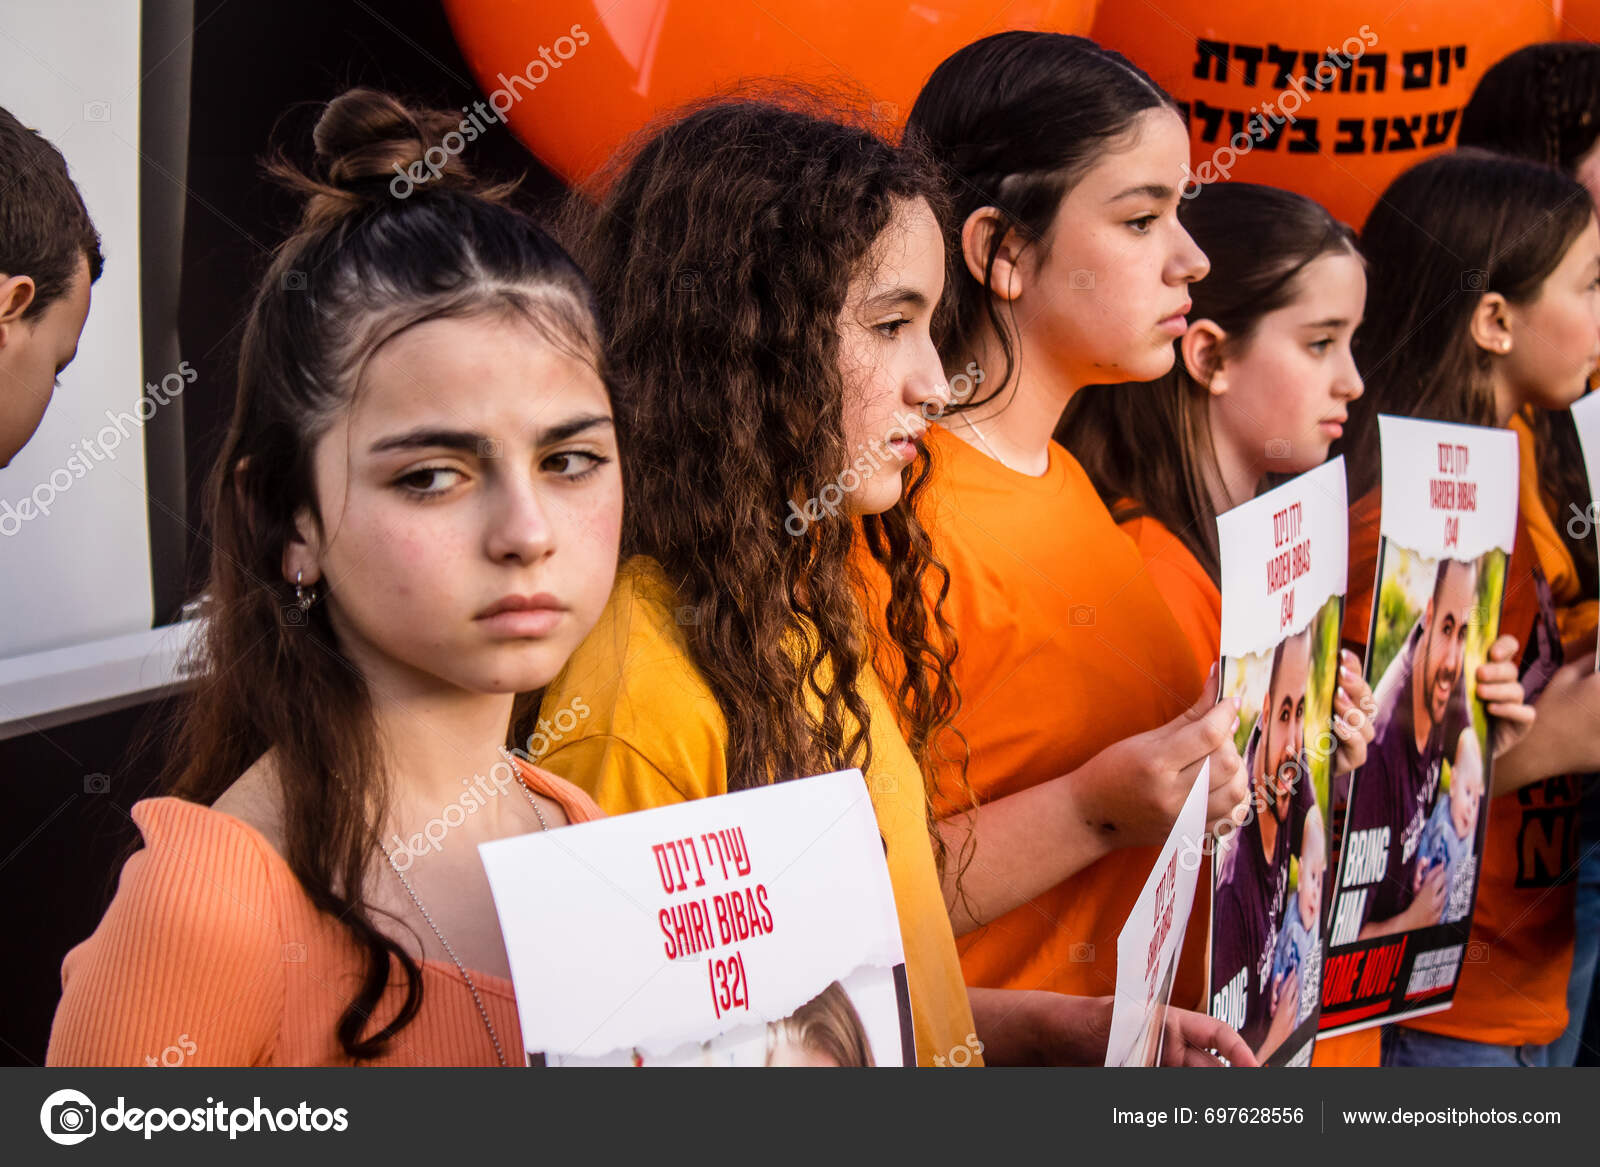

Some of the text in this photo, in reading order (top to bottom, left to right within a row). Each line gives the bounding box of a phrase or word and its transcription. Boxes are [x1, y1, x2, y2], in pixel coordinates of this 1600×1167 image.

[1401, 45, 1466, 90] יום
[1267, 538, 1311, 596] YARDEN BIBAS
[651, 825, 752, 895] שירי ביבס
[1342, 825, 1391, 888] BRING
[658, 883, 774, 961] SHIRI BIBAS
[708, 950, 750, 1020] (32)
[1355, 934, 1409, 1000] NOW!
